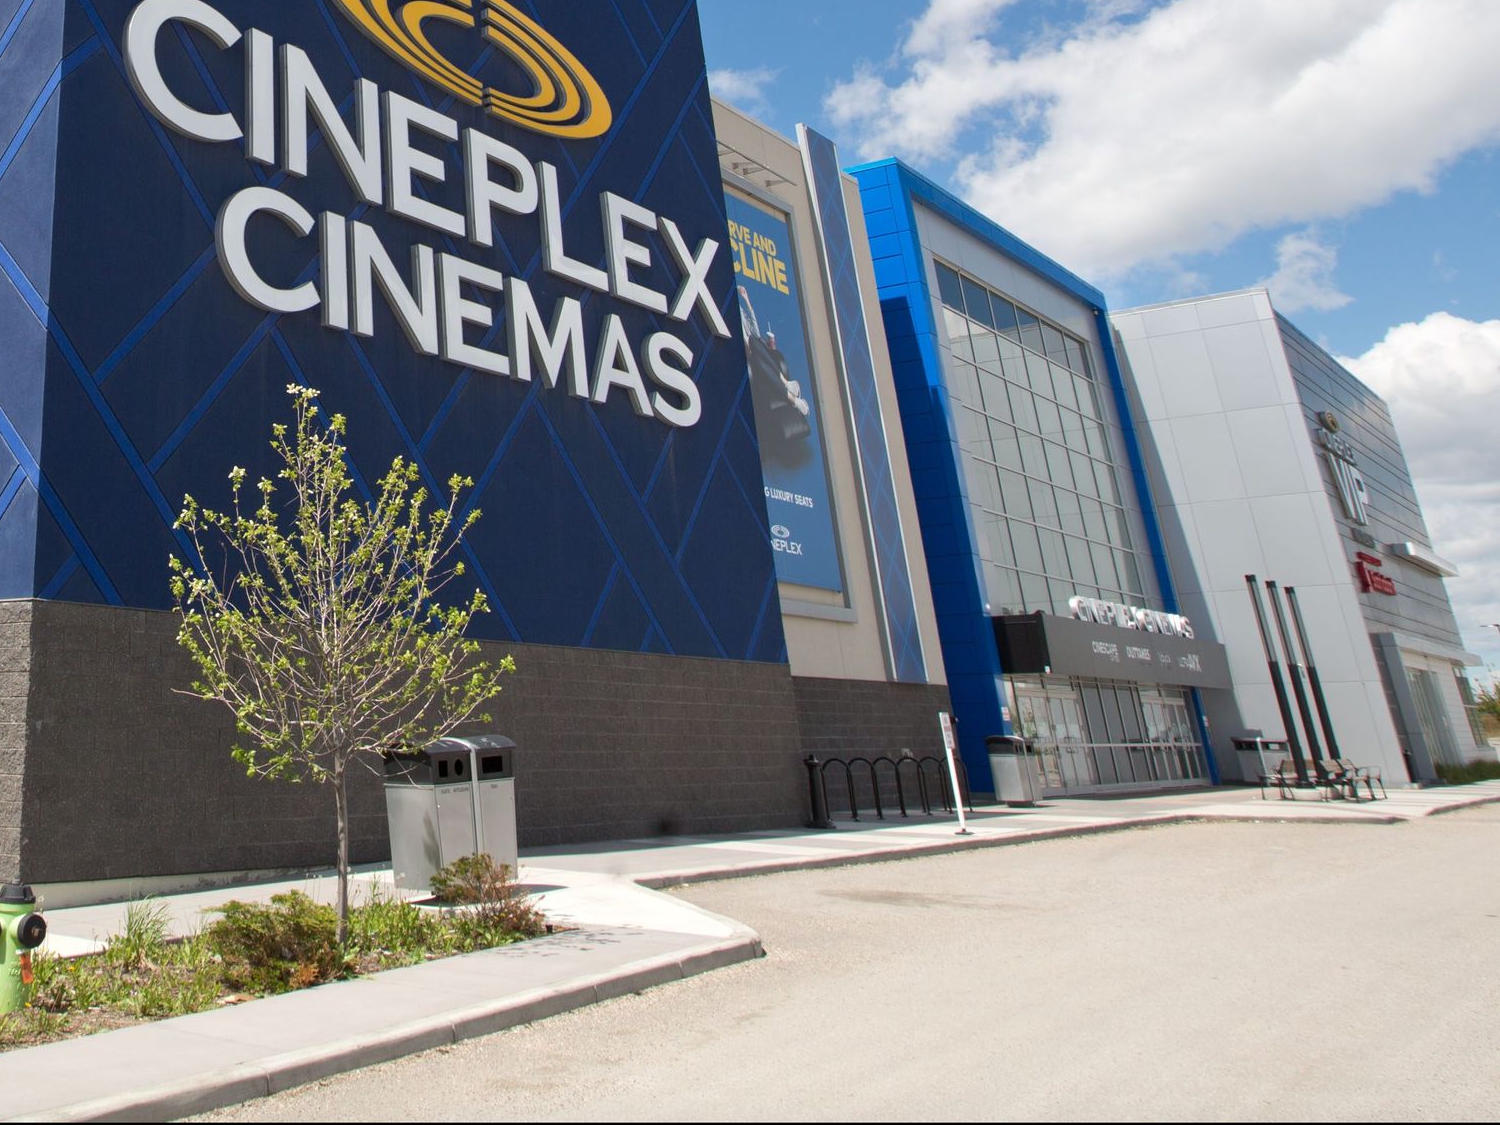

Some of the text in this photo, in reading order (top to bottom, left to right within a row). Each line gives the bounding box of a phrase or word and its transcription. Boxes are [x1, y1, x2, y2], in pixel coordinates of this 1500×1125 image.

[753, 232, 777, 256] AND
[214, 186, 702, 427] CINEMAS
[770, 488, 793, 503] LUXURY
[794, 494, 813, 508] SEATS
[1324, 452, 1369, 527] VIP
[1069, 596, 1194, 639] CINEPLEX CINEMAS
